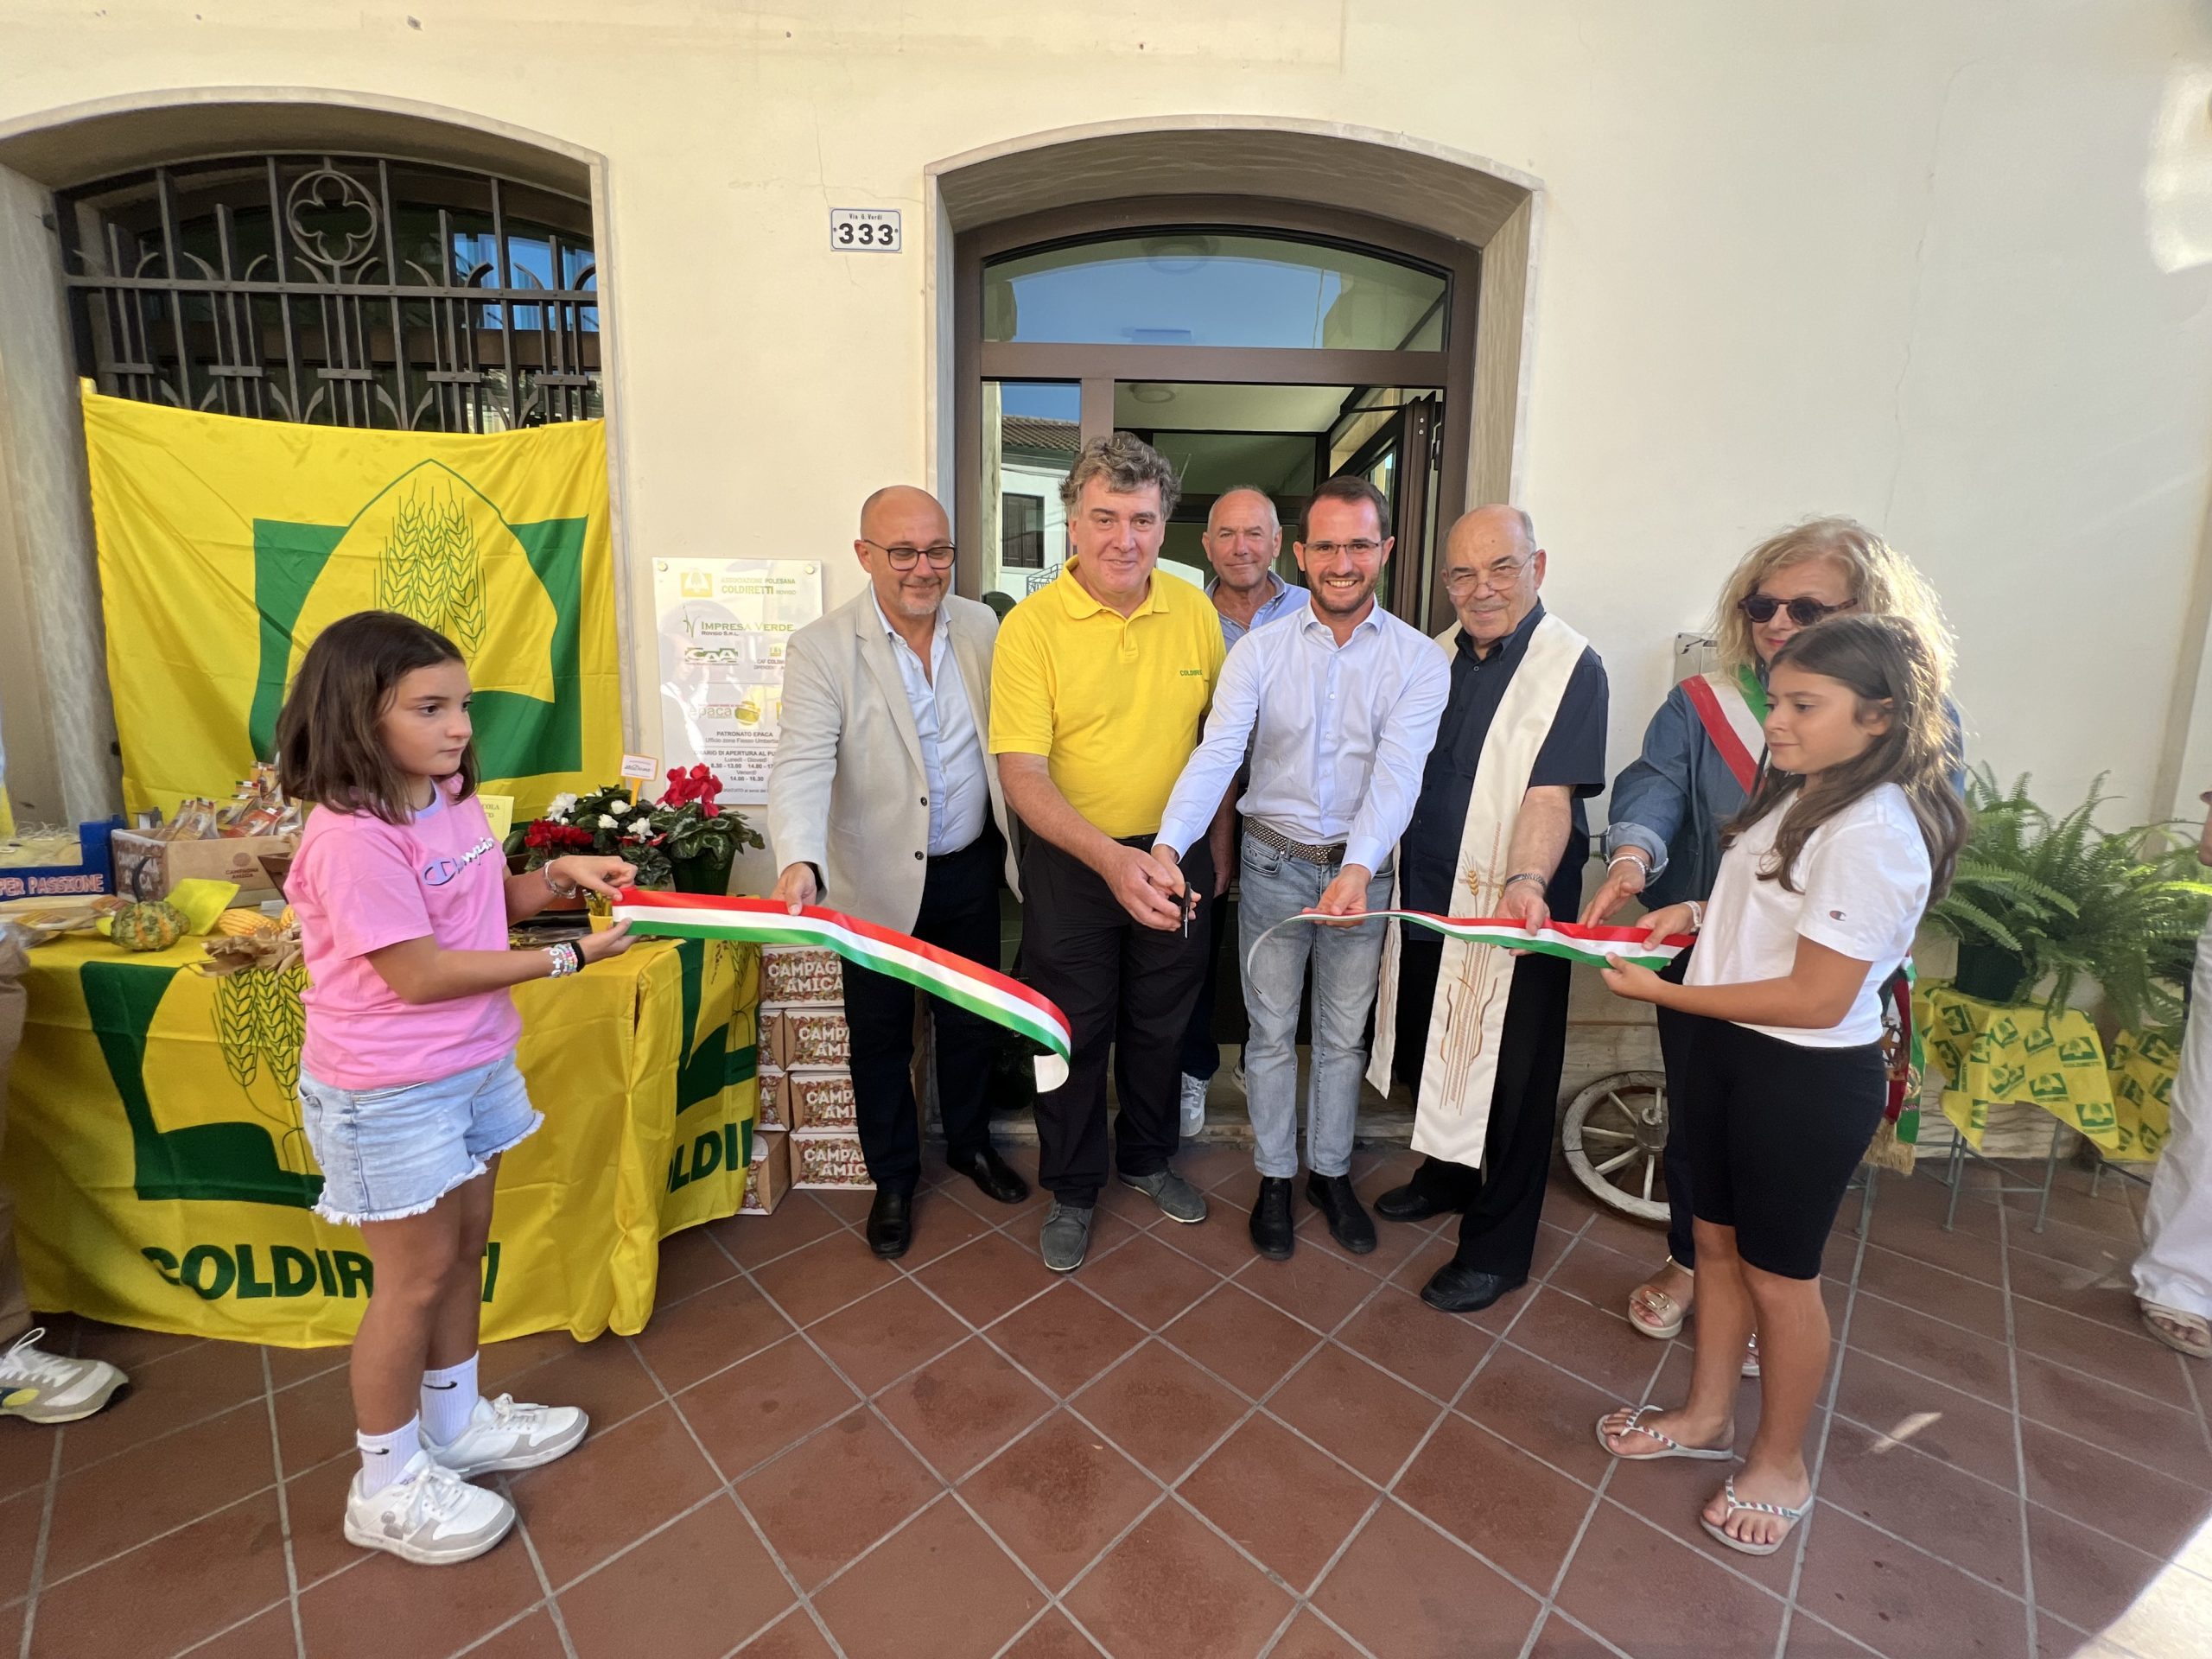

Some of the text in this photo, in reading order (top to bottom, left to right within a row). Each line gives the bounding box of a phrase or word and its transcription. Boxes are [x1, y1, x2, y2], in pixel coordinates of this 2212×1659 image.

[839, 223, 893, 246] 333
[721, 585, 773, 594] COLDIRETTI
[702, 621, 795, 632] IMPRESA VERDE
[28, 874, 105, 895] PASSIONE
[786, 976, 843, 992] AMICA
[816, 1042, 851, 1056] AMI
[806, 1090, 855, 1104] CAMP
[824, 1104, 856, 1118] AMI
[667, 1116, 754, 1194] LDI
[822, 1162, 868, 1176] AMIC
[141, 1243, 502, 1303] COLDIRI
